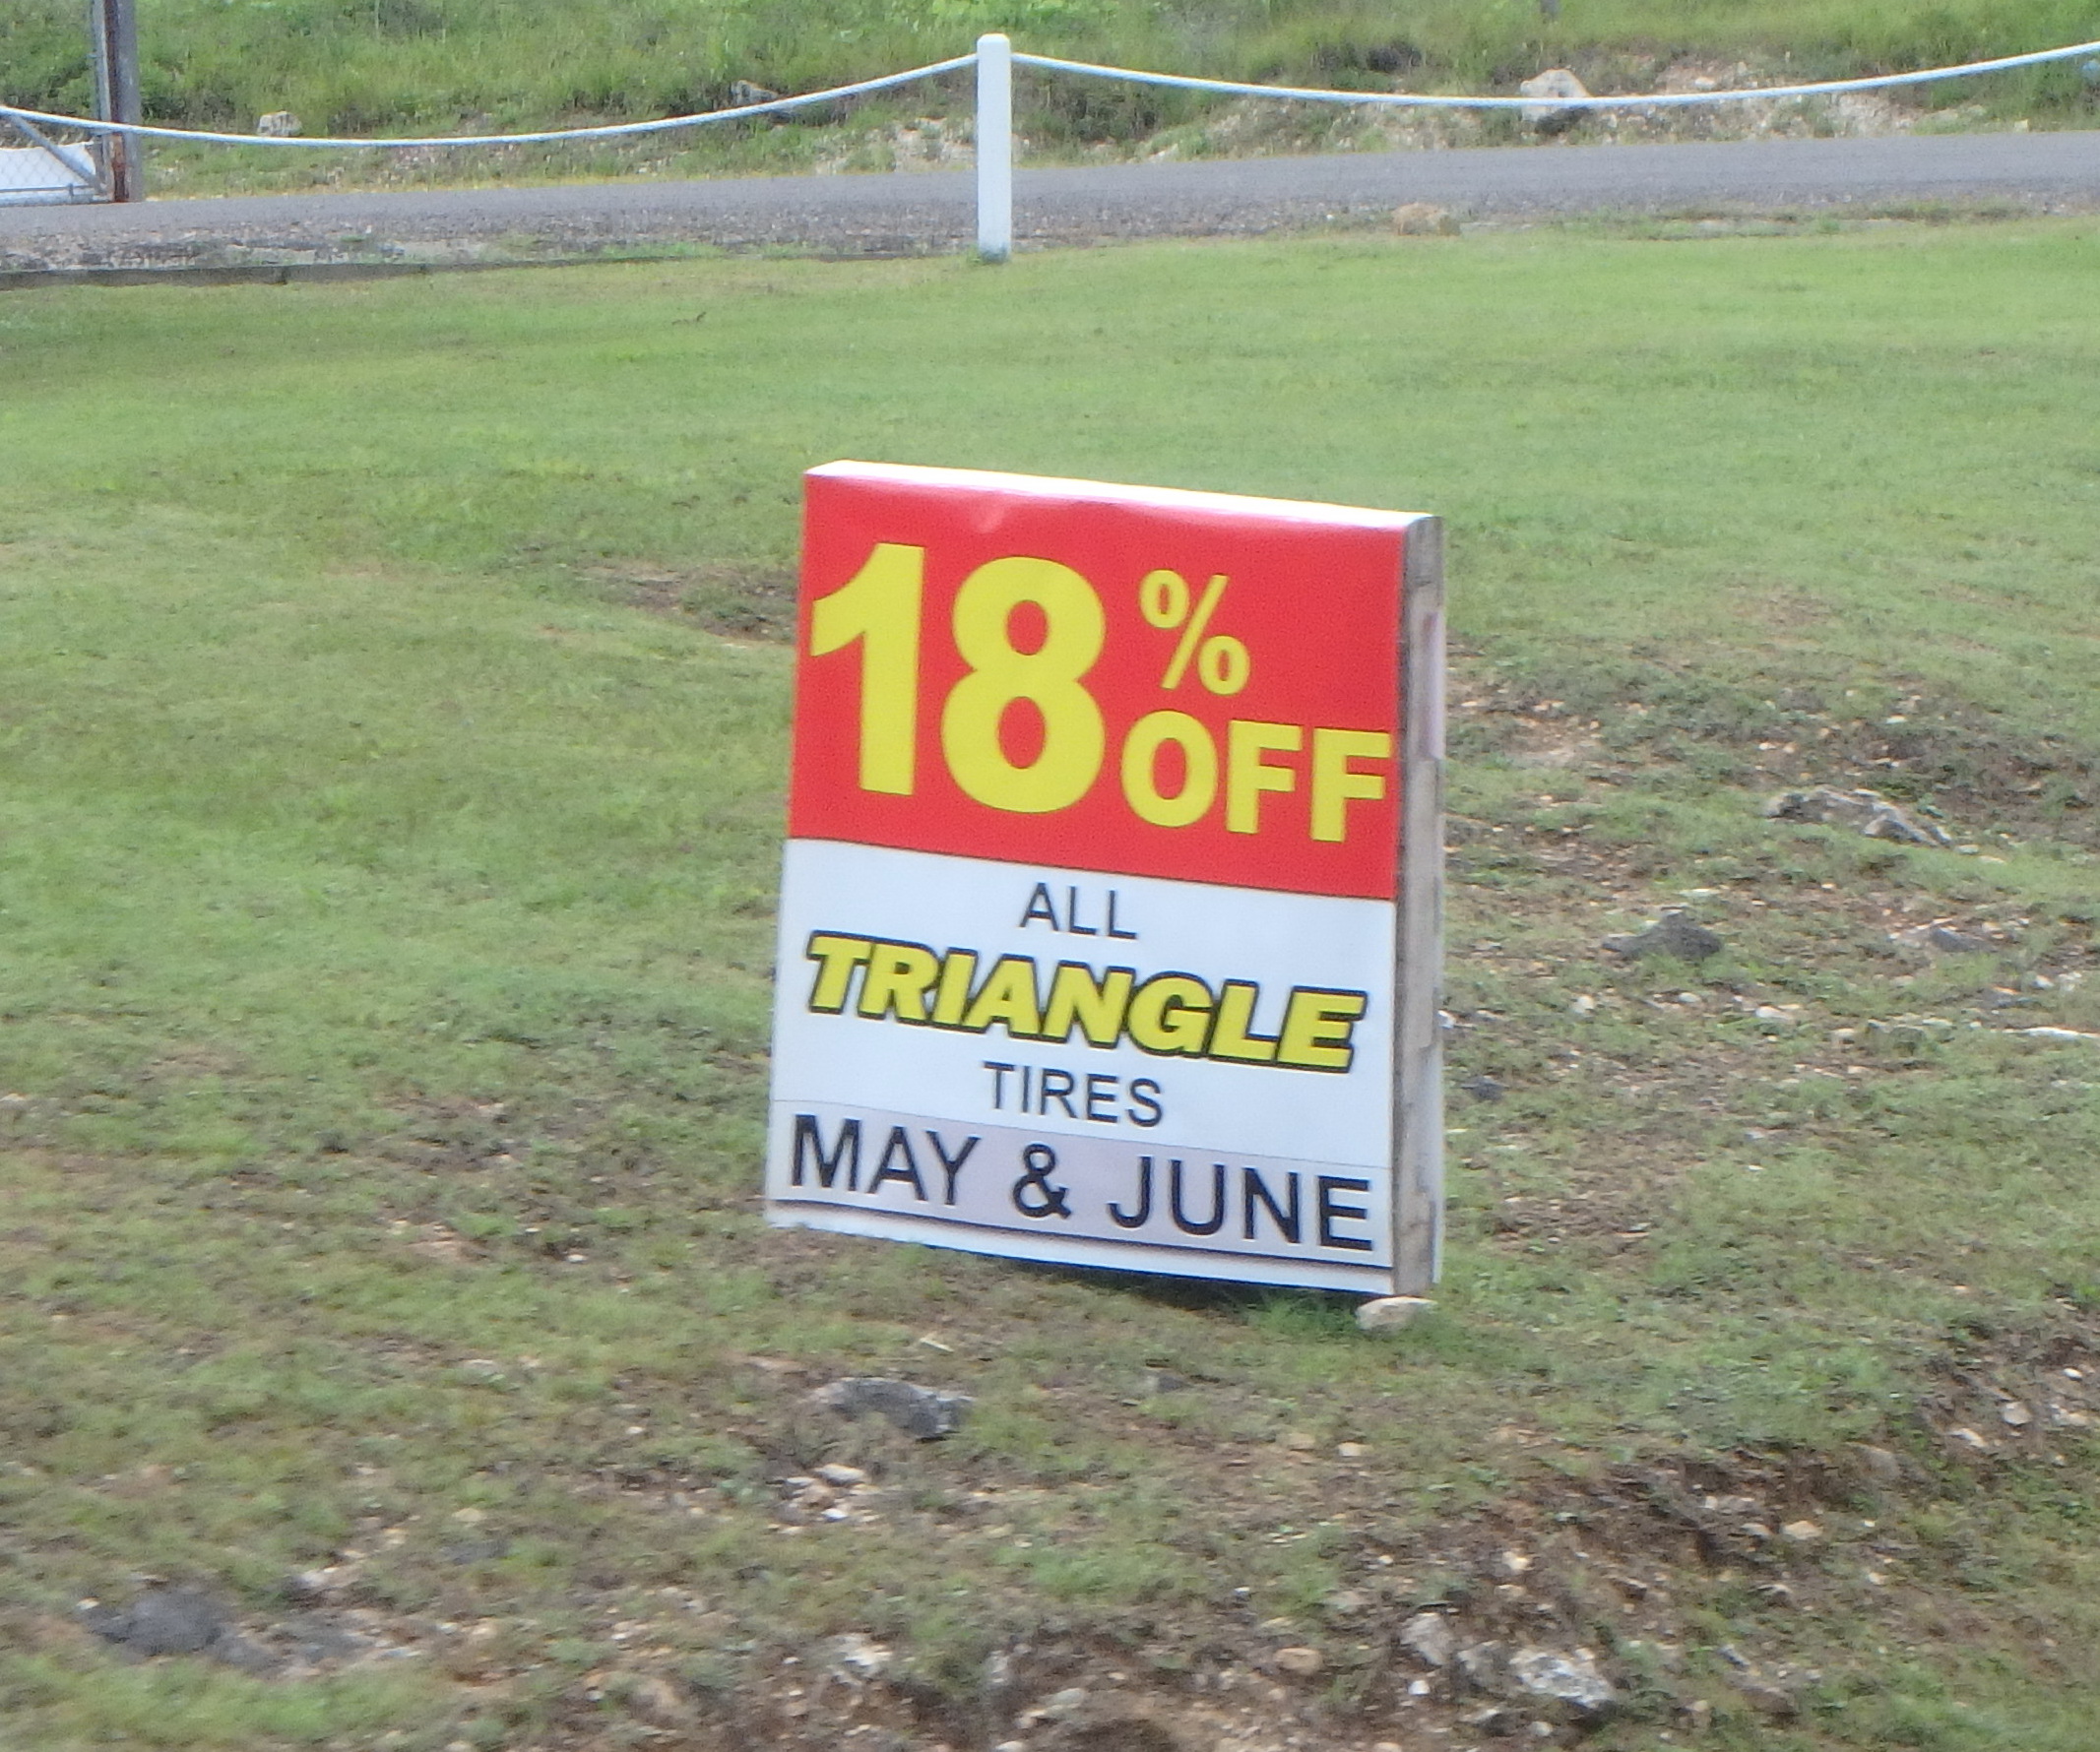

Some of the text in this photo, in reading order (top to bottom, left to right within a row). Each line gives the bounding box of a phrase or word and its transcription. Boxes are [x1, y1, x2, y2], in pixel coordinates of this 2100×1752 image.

[1120, 711, 1392, 843] OFF
[1019, 882, 1137, 940] ALL
[806, 931, 1367, 1073] TRIANGLE
[984, 1062, 1164, 1128] TIRES
[791, 1114, 1374, 1251] MAY & JUNE
